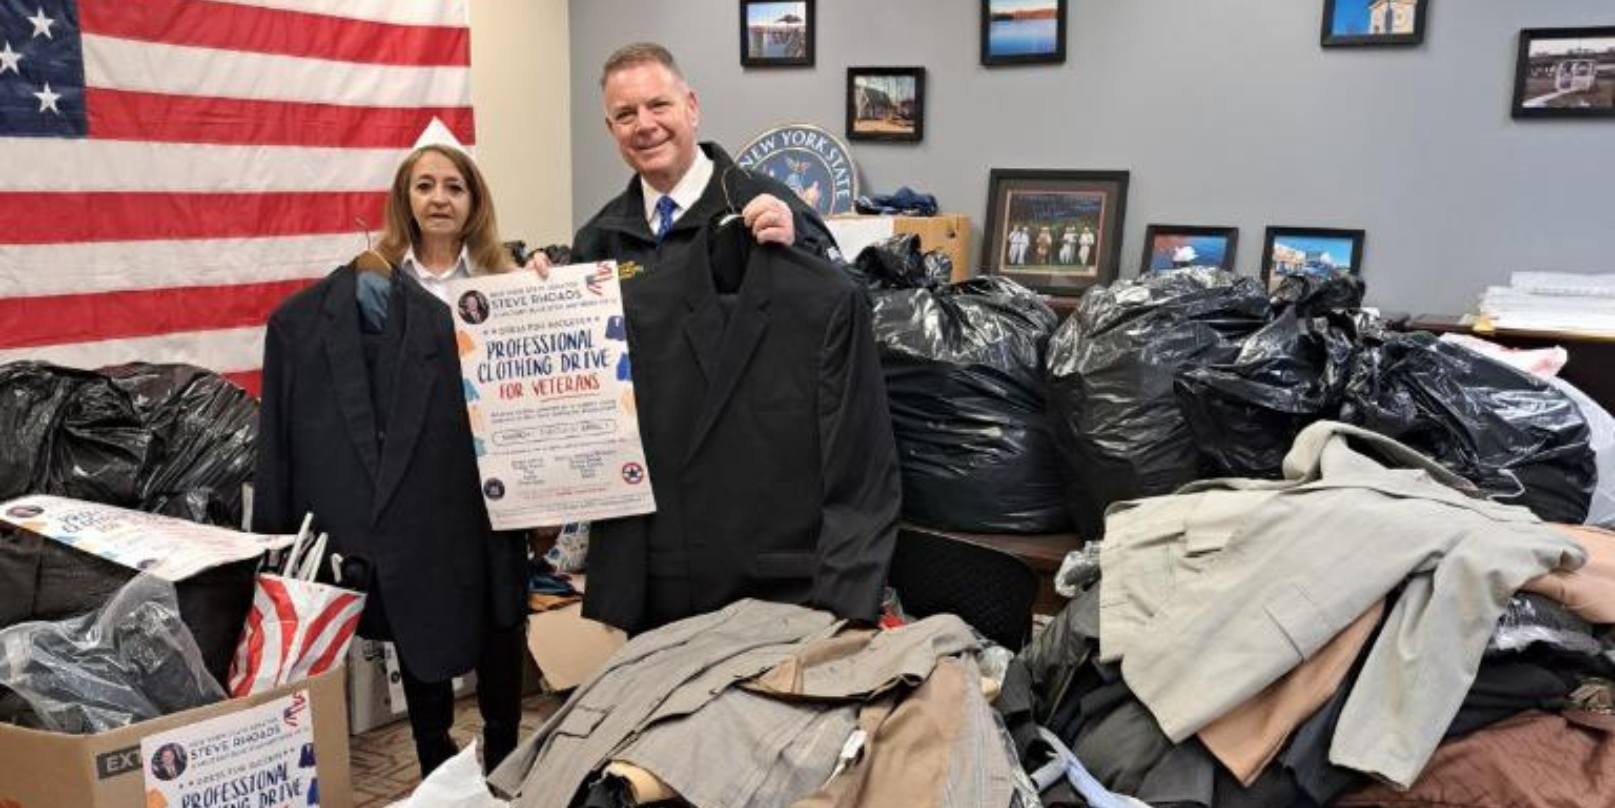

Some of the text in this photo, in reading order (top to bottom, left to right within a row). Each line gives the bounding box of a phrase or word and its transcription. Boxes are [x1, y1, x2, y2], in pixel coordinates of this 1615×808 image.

[740, 130, 851, 199] NEW YORK STATE
[491, 296, 528, 309] STEVE
[531, 289, 583, 305] RHOADS
[487, 330, 594, 359] PROFESSIONAL
[477, 348, 610, 384] CLOTHING DRIVE
[499, 373, 600, 400] FOR VETERANS
[190, 740, 228, 760] STEVE
[233, 725, 280, 748] RHOADS
[182, 761, 288, 808] PROFESSIONAL
[259, 778, 301, 808] DRIVE
